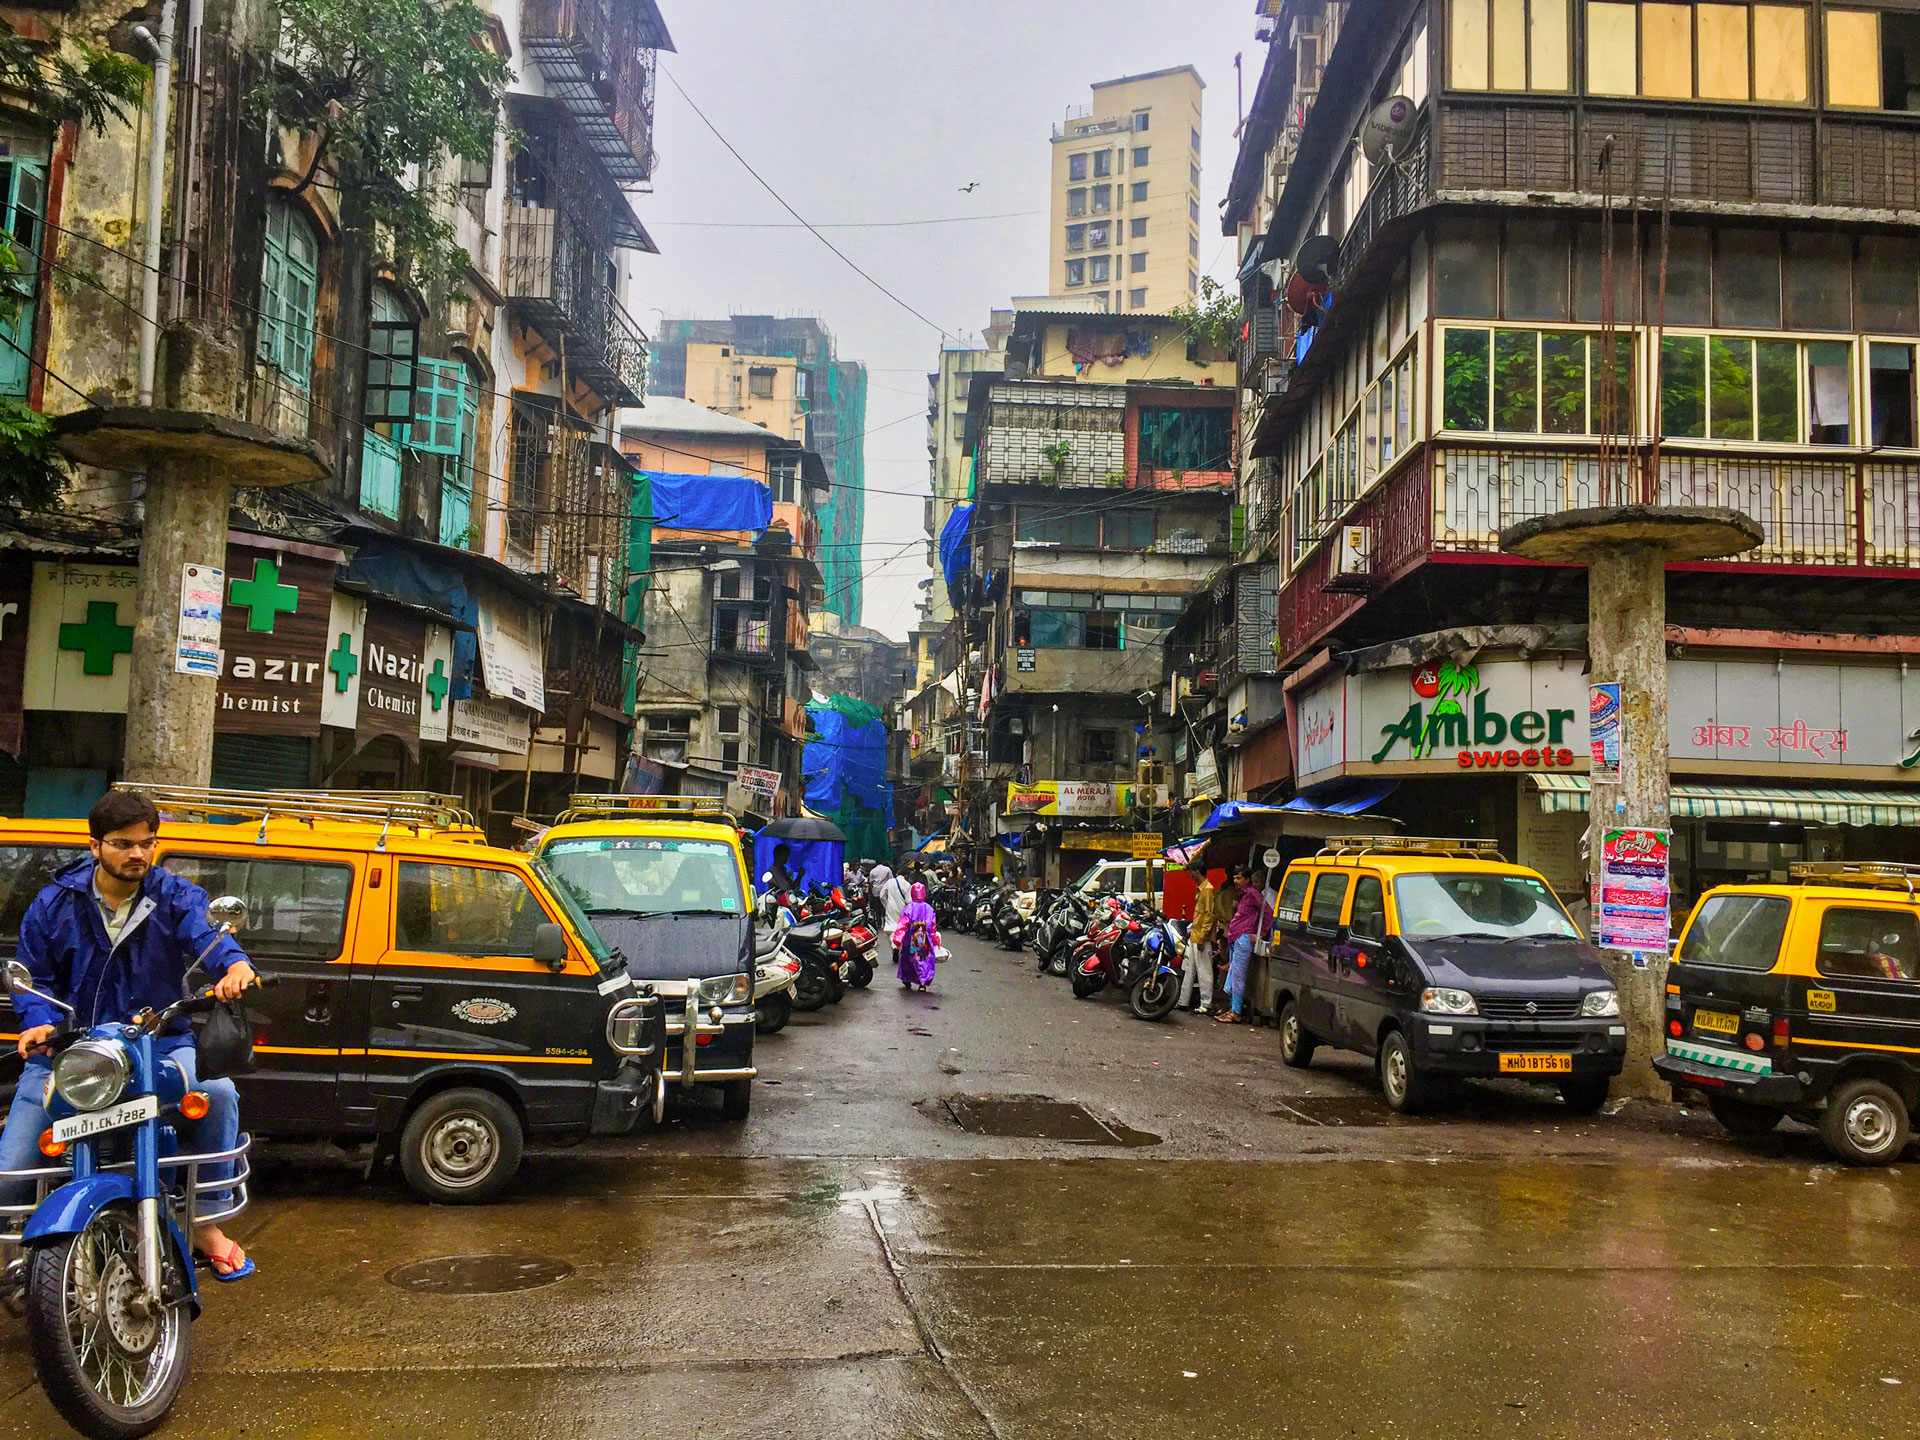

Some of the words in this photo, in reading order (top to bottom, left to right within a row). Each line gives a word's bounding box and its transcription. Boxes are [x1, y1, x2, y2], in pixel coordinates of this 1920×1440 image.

[217, 649, 319, 684] azir
[368, 643, 424, 684] Nazir
[215, 692, 301, 714] hemist
[368, 687, 416, 715] Chemist
[1371, 687, 1575, 763] Amber
[1691, 717, 1751, 748] अंबर
[1765, 719, 1849, 759] स्वीट्स
[1457, 747, 1574, 767] sweets
[741, 776, 755, 785] STD
[1063, 787, 1075, 795] AL
[630, 799, 657, 808] TAXI
[1133, 833, 1141, 841] NO
[1507, 1057, 1570, 1069] MH01BT5618
[60, 1108, 146, 1139] MH.01.CK.7282
